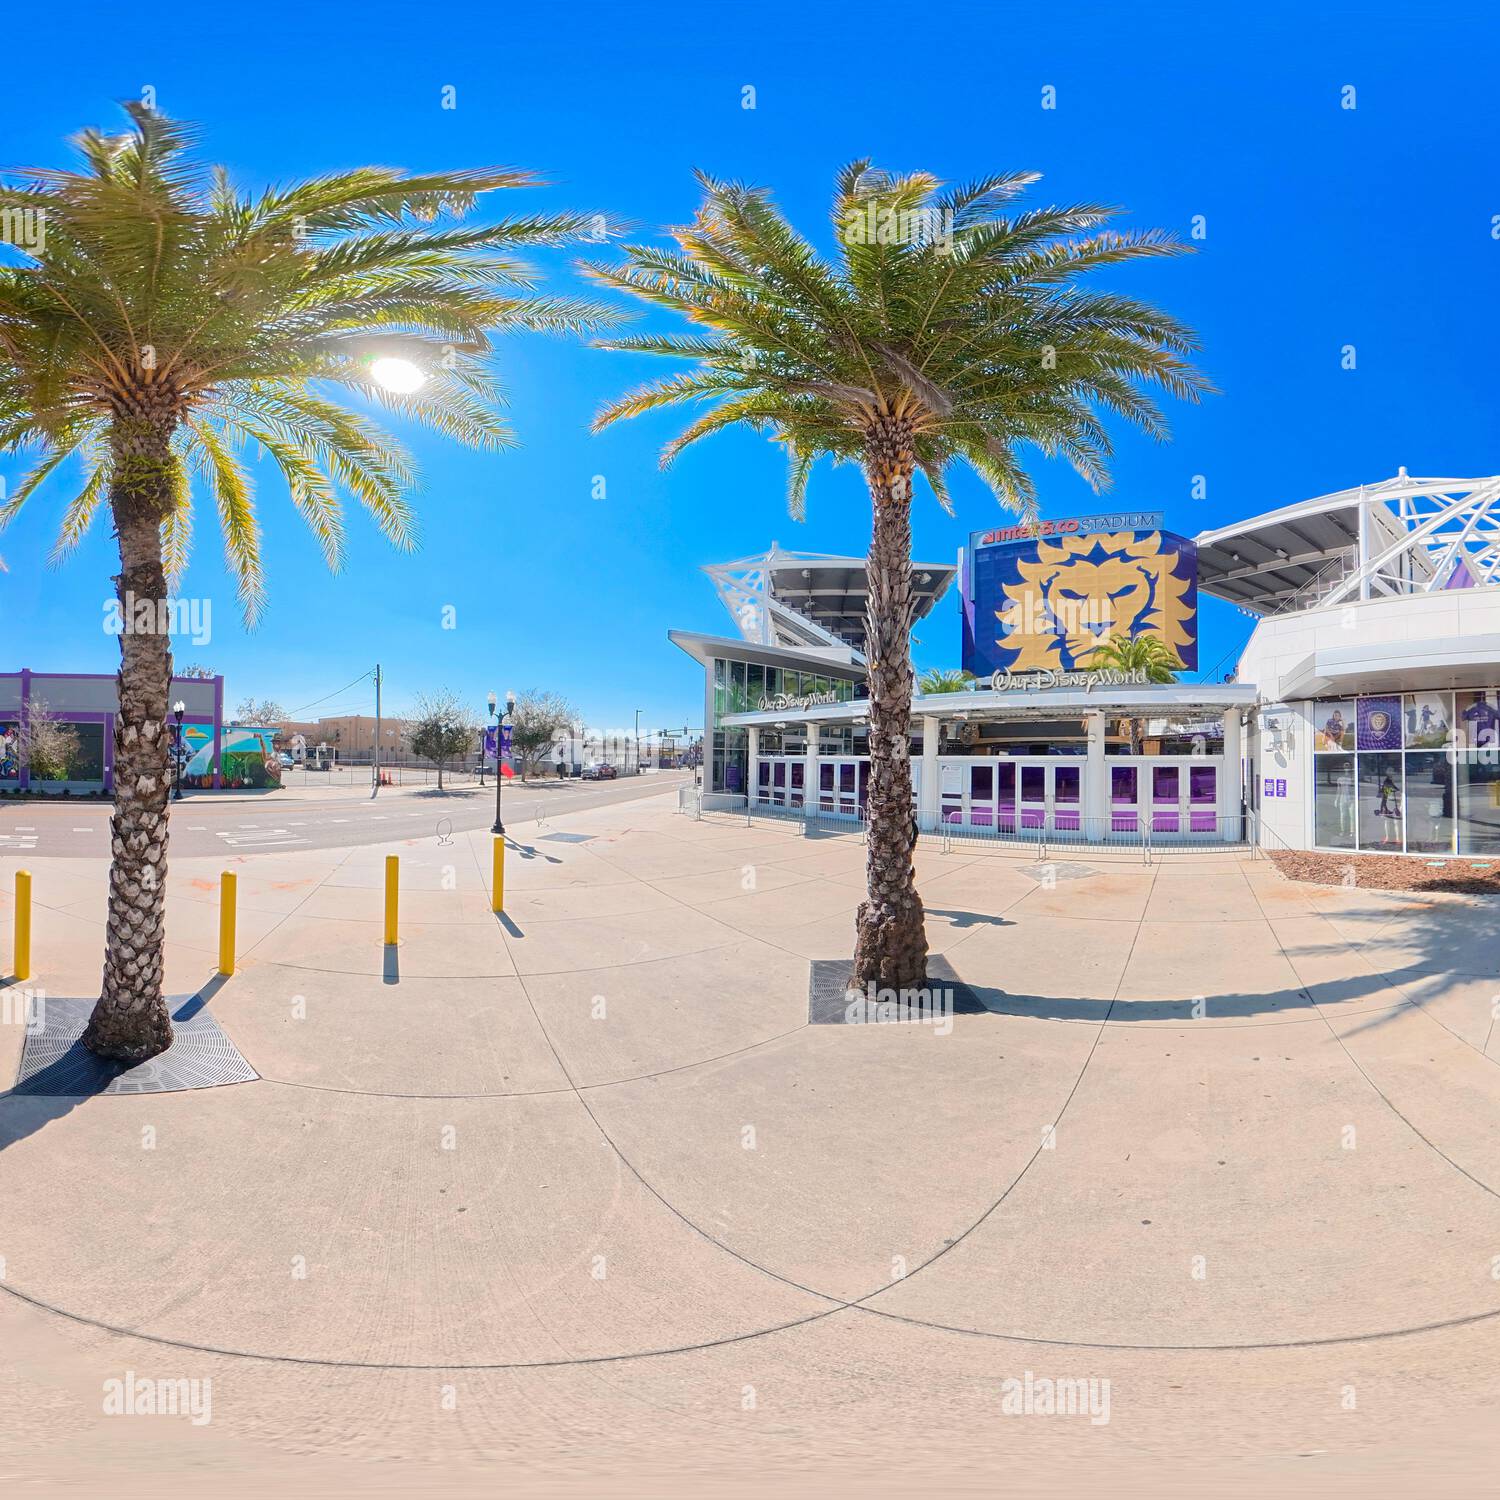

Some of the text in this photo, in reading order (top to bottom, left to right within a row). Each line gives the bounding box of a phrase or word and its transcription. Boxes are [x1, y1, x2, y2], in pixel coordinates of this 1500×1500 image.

[1081, 514, 1155, 530] STADIUM
[1096, 666, 1147, 685] World
[808, 690, 837, 706] World
